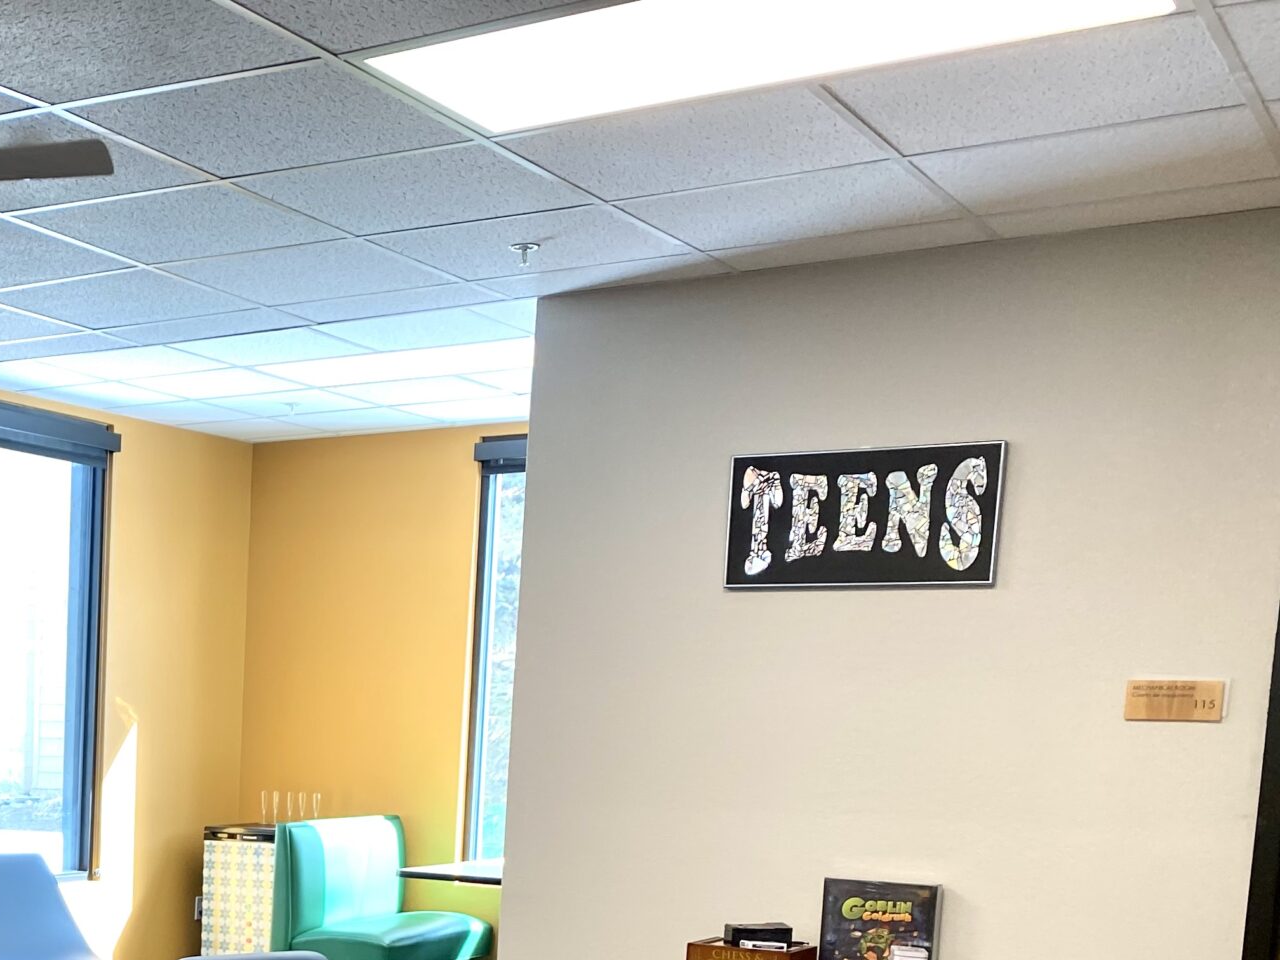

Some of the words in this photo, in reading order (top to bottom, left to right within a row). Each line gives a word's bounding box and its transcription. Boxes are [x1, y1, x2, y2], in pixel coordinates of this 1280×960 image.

[740, 456, 988, 576] TEENS
[1194, 699, 1216, 710] 115
[712, 948, 751, 960] CHESS
